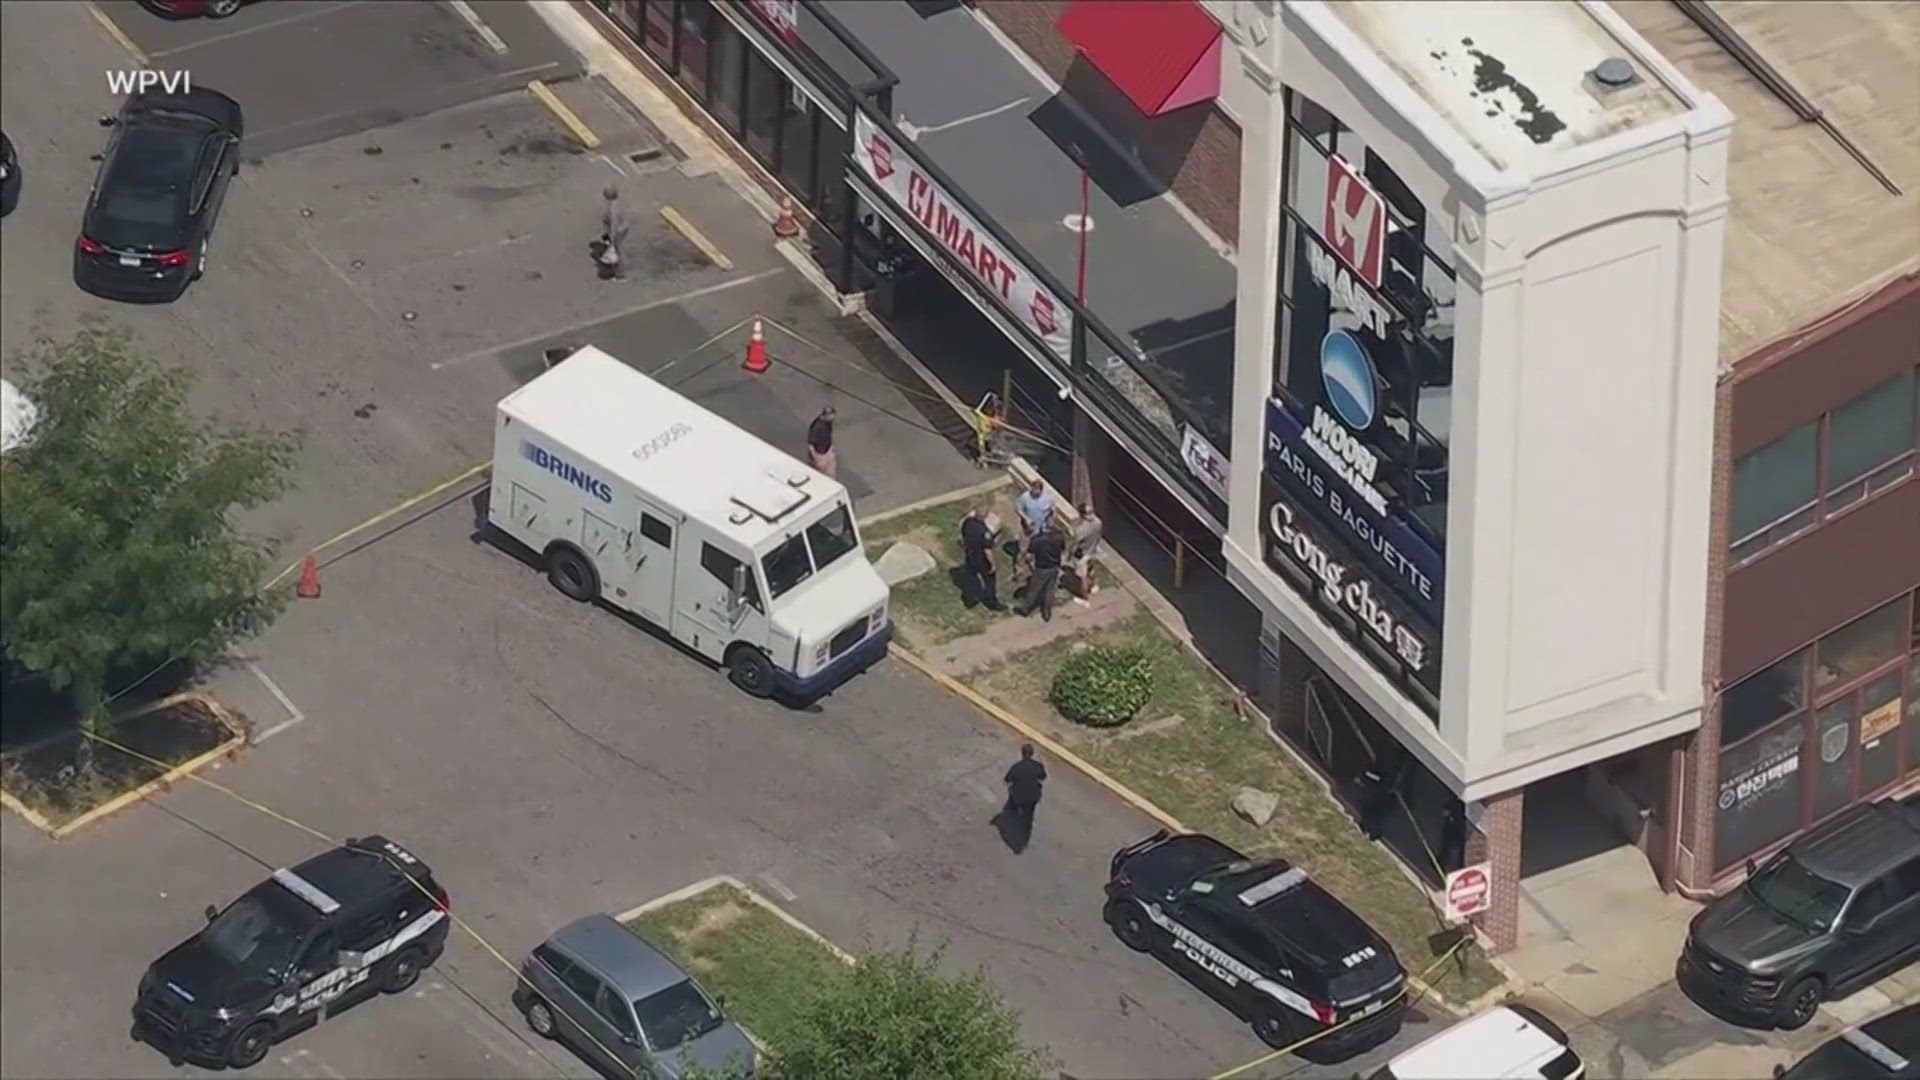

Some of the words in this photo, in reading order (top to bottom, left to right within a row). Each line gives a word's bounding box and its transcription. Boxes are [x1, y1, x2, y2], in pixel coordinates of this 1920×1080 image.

[937, 201, 1016, 300] MART
[1305, 233, 1391, 341] MART
[536, 447, 613, 504] BRINKS
[1312, 405, 1379, 483] WOORI
[1268, 431, 1325, 499] PARIS
[1329, 489, 1433, 601] BAGUETTE
[1269, 501, 1347, 604] Gong
[1346, 579, 1393, 644] cha
[1172, 939, 1239, 989] POLICE
